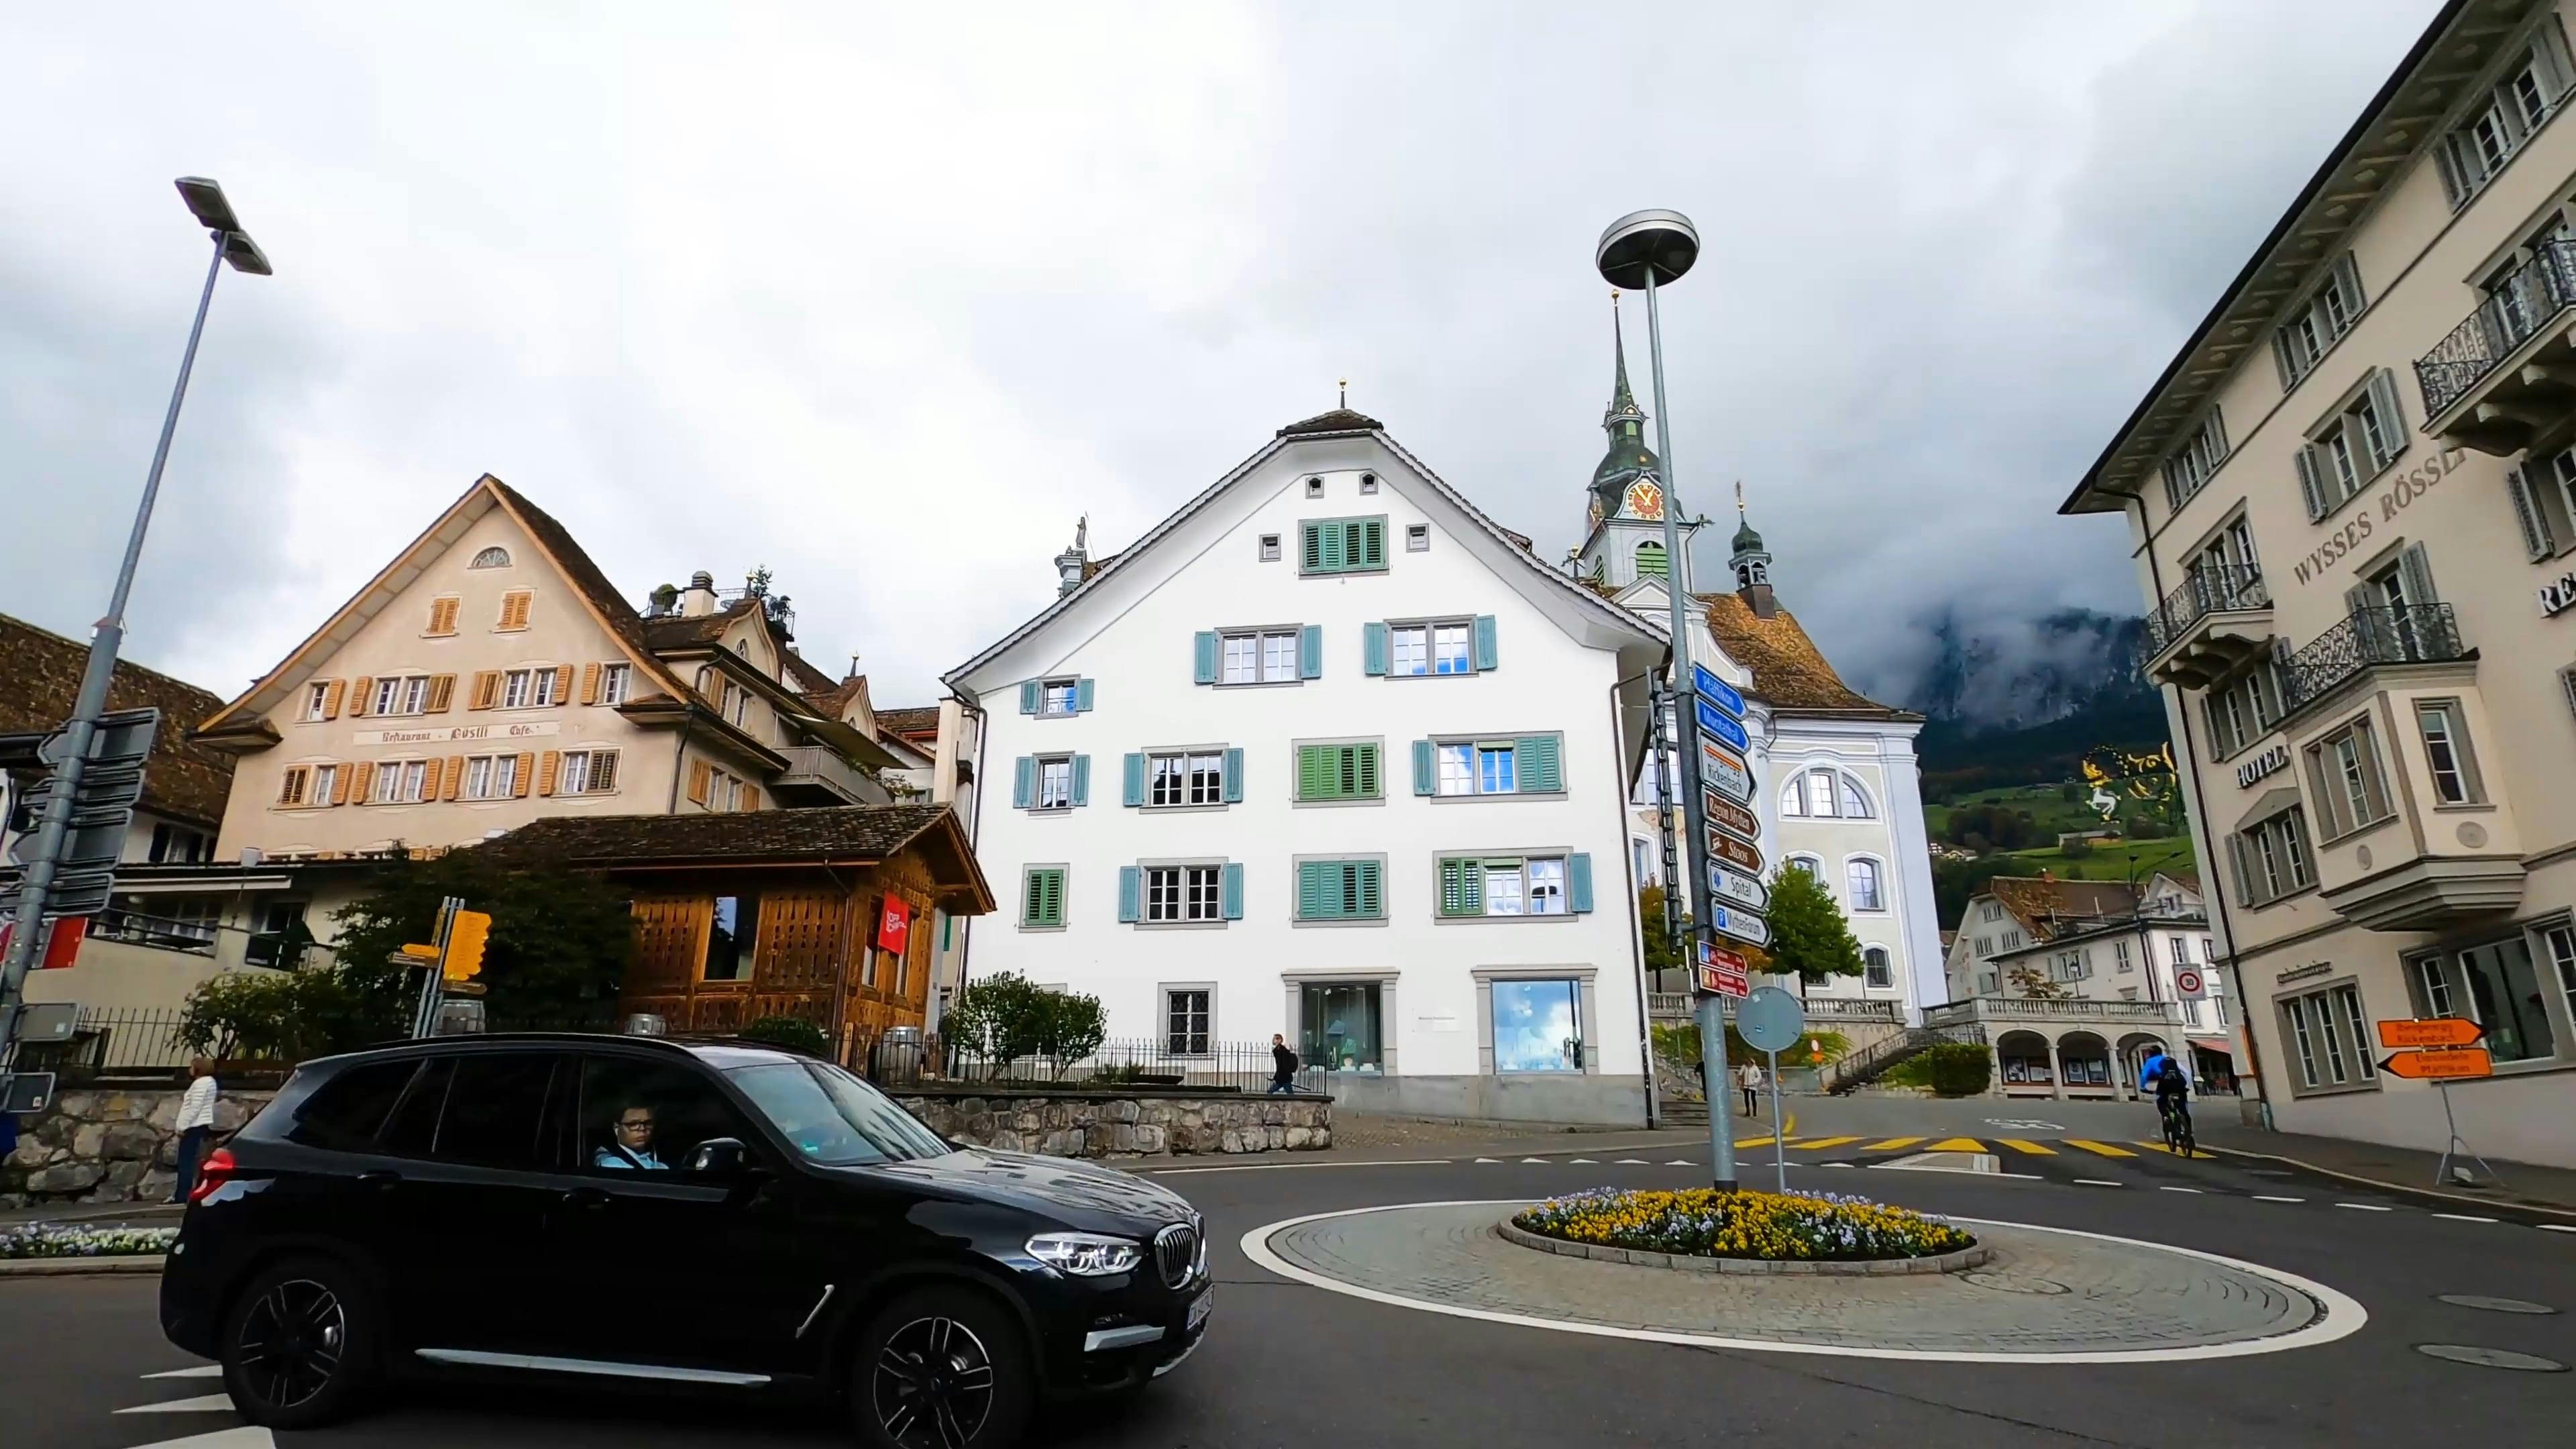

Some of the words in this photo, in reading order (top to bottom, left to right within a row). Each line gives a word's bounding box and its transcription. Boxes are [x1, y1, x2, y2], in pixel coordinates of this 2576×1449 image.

[2294, 511, 2372, 586] WYSSES
[2236, 745, 2287, 789] HOTEL
[1709, 797, 1729, 820] Region
[1729, 806, 1750, 829] Mythen
[1728, 841, 1748, 863] Stoos
[1731, 877, 1752, 898] Spital
[2185, 977, 2194, 986] 30
